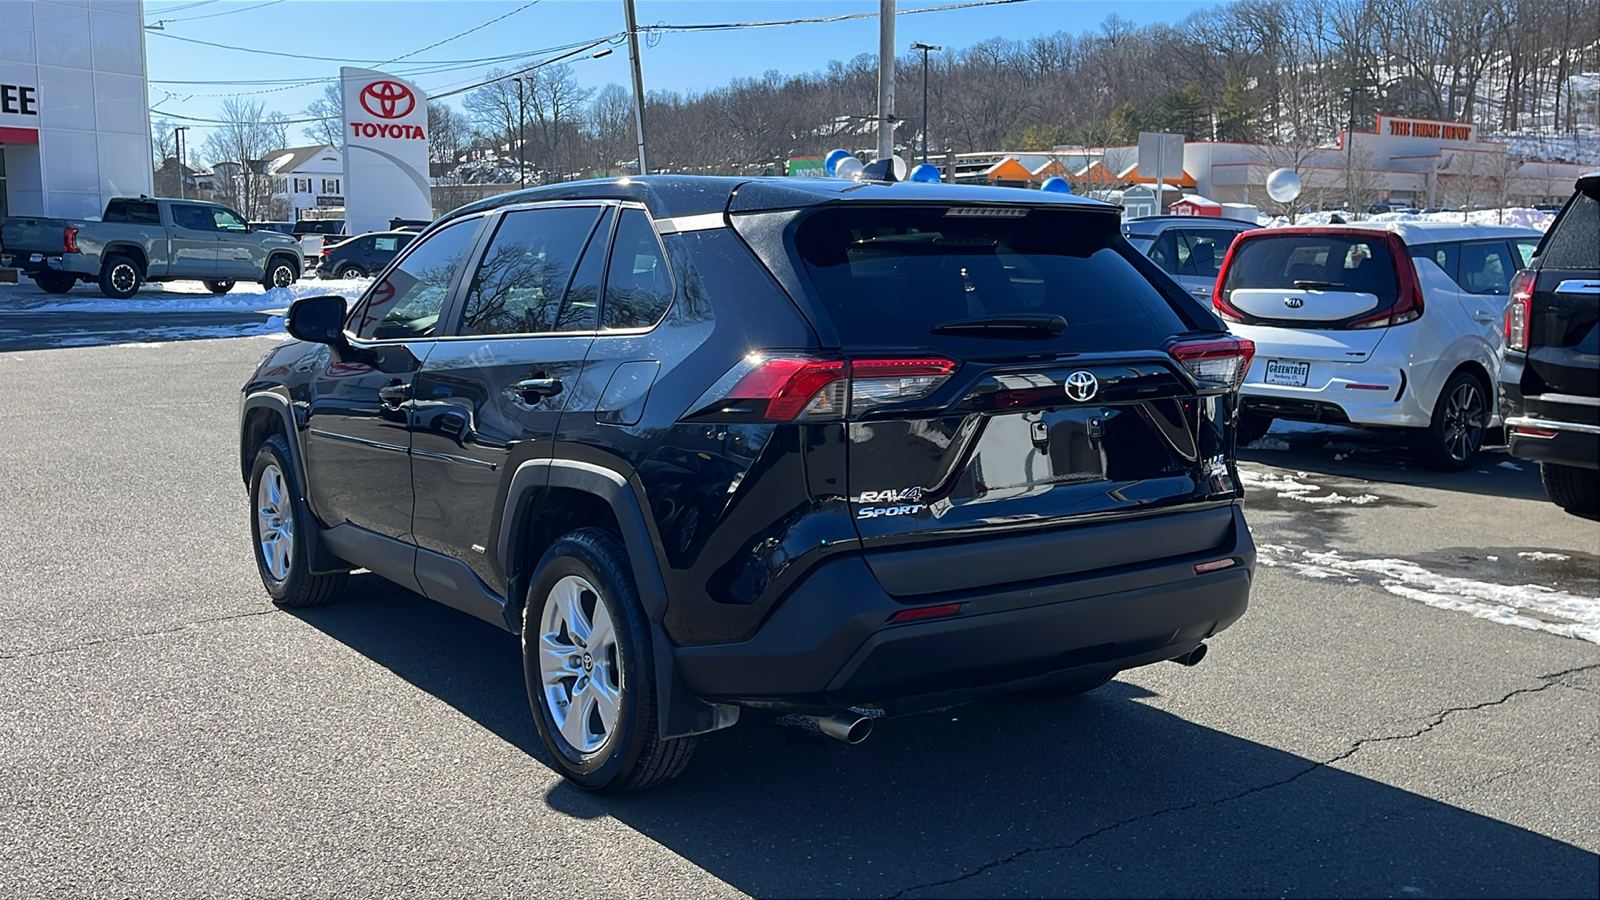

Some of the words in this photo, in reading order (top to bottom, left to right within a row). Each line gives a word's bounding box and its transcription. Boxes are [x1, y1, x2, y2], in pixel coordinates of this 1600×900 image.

[0, 84, 37, 115] EE
[350, 122, 426, 140] TOYOTA
[1390, 120, 1411, 136] THE
[1412, 122, 1441, 138] HOME
[1442, 125, 1472, 141] DEPOT
[1286, 298, 1302, 308] KIA
[1269, 364, 1306, 376] GREENTREE
[858, 486, 922, 504] RAV4
